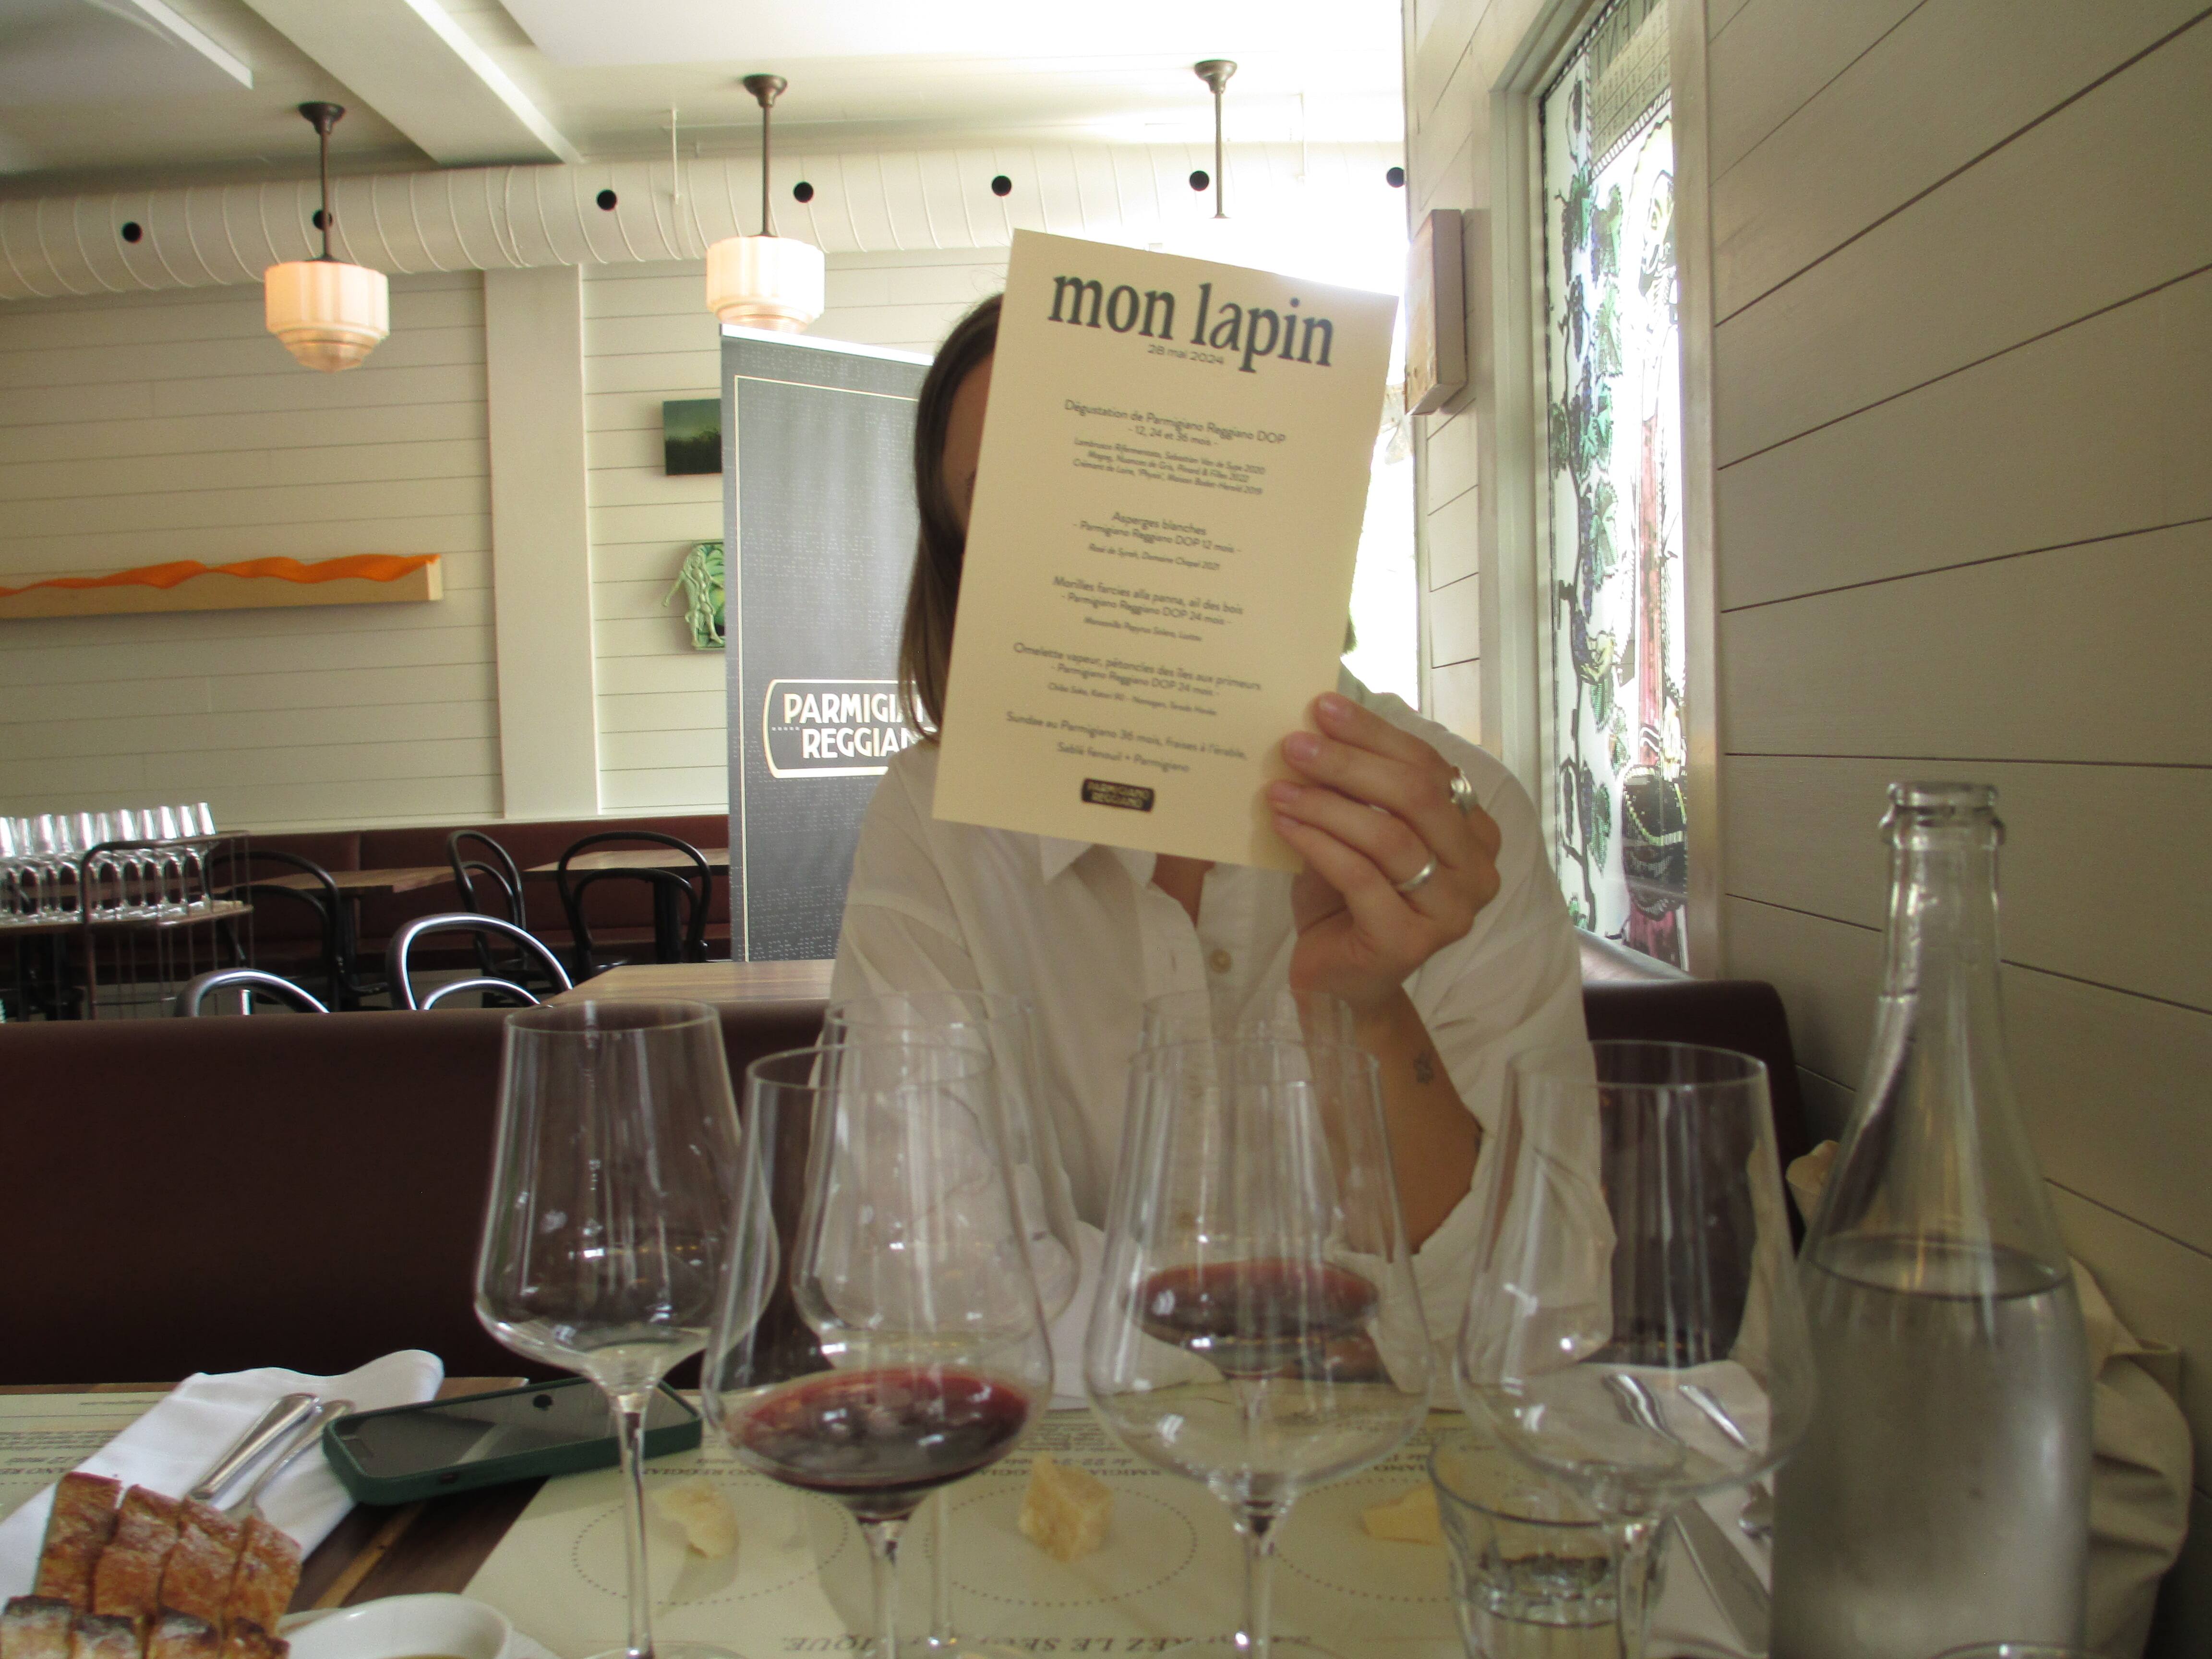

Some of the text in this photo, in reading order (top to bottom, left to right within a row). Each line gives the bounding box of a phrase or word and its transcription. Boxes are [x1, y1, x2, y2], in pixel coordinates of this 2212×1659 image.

[1047, 275, 1333, 373] mon lapin
[1147, 343, 1225, 365] 28 mai 2024
[783, 693, 924, 724] PARMIGI
[802, 727, 925, 759] REGGIAN
